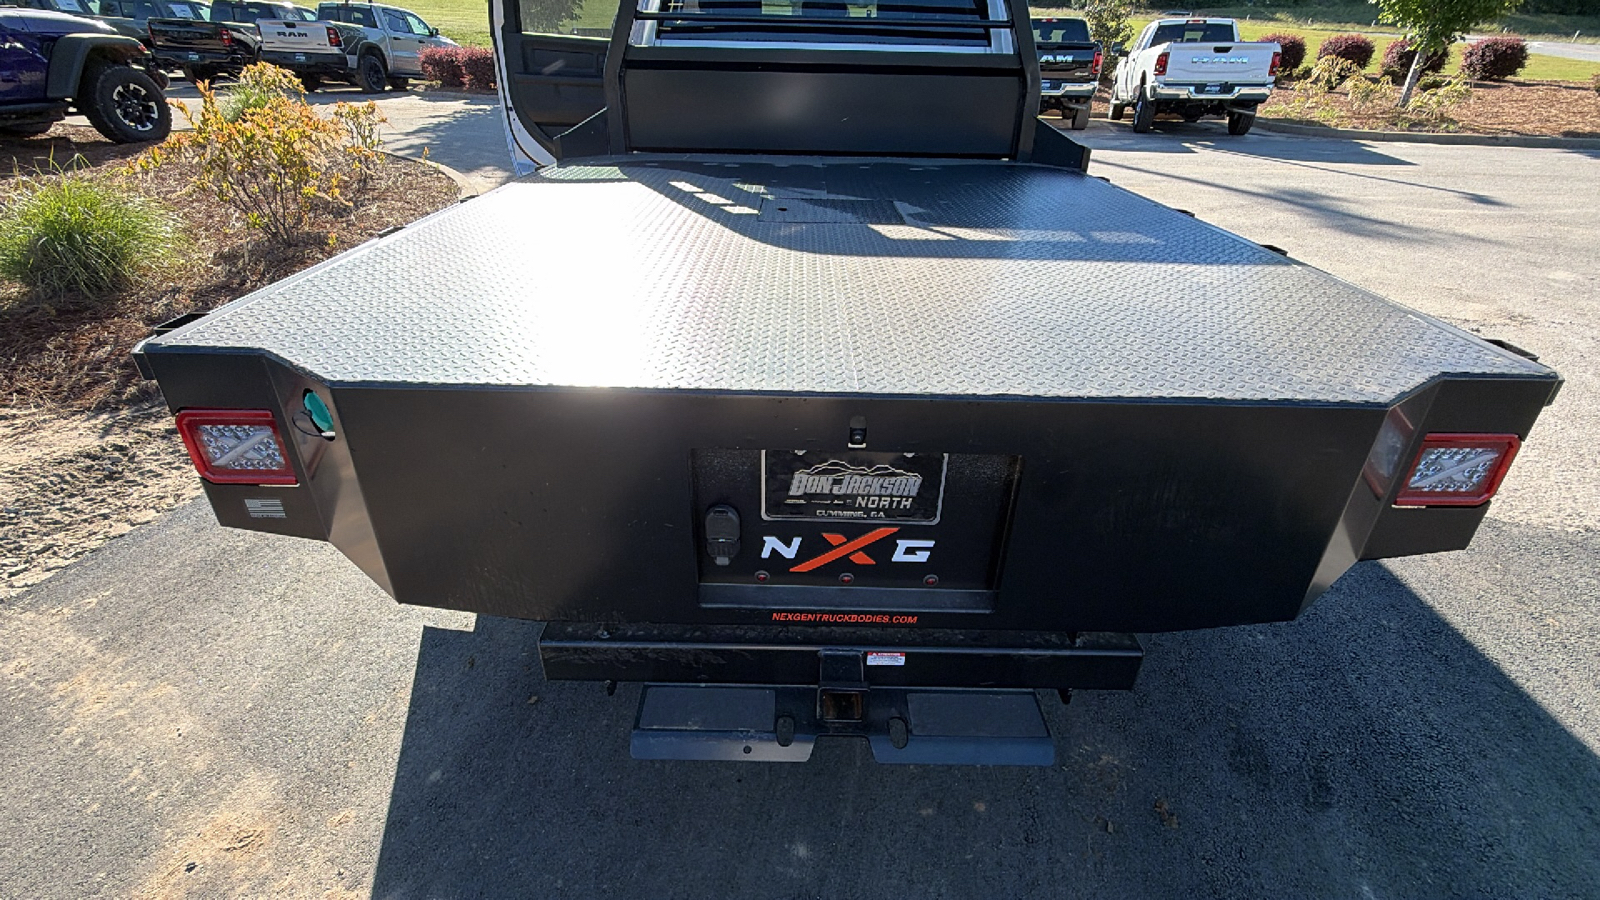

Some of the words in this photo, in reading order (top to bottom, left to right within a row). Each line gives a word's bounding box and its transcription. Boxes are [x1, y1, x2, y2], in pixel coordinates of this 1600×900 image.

[1040, 54, 1074, 63] AM
[1191, 56, 1250, 64] RAM
[788, 473, 833, 496] DON
[831, 475, 923, 497] JACKSON
[855, 496, 913, 509] NORTH
[772, 612, 918, 624] NEXGENTRUCKBODIES.COM
